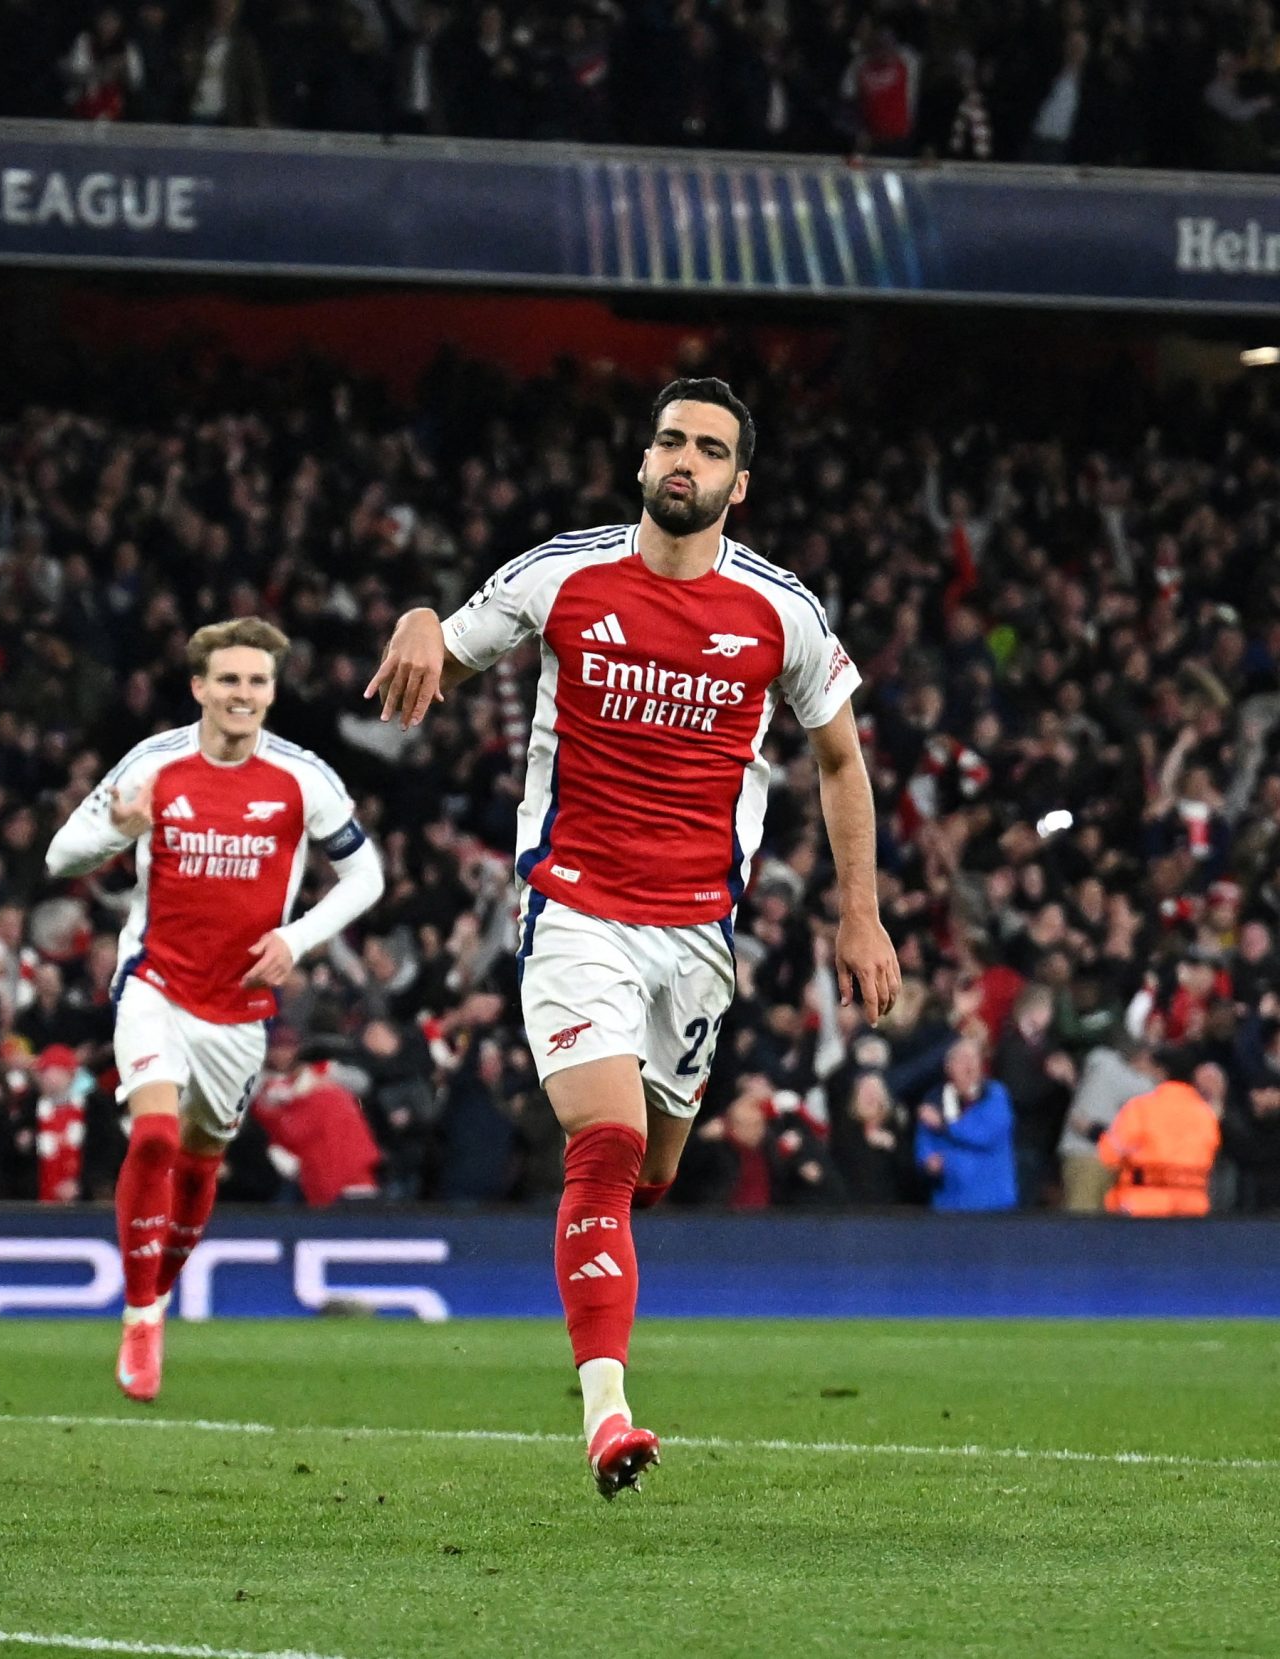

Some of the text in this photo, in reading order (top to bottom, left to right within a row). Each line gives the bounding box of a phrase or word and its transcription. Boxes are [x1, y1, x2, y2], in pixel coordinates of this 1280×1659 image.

[581, 651, 746, 705] Emirates
[600, 692, 718, 733] FLY BETTER
[163, 825, 277, 857] Emirates
[205, 855, 260, 879] BETTER
[565, 1216, 618, 1239] AFC
